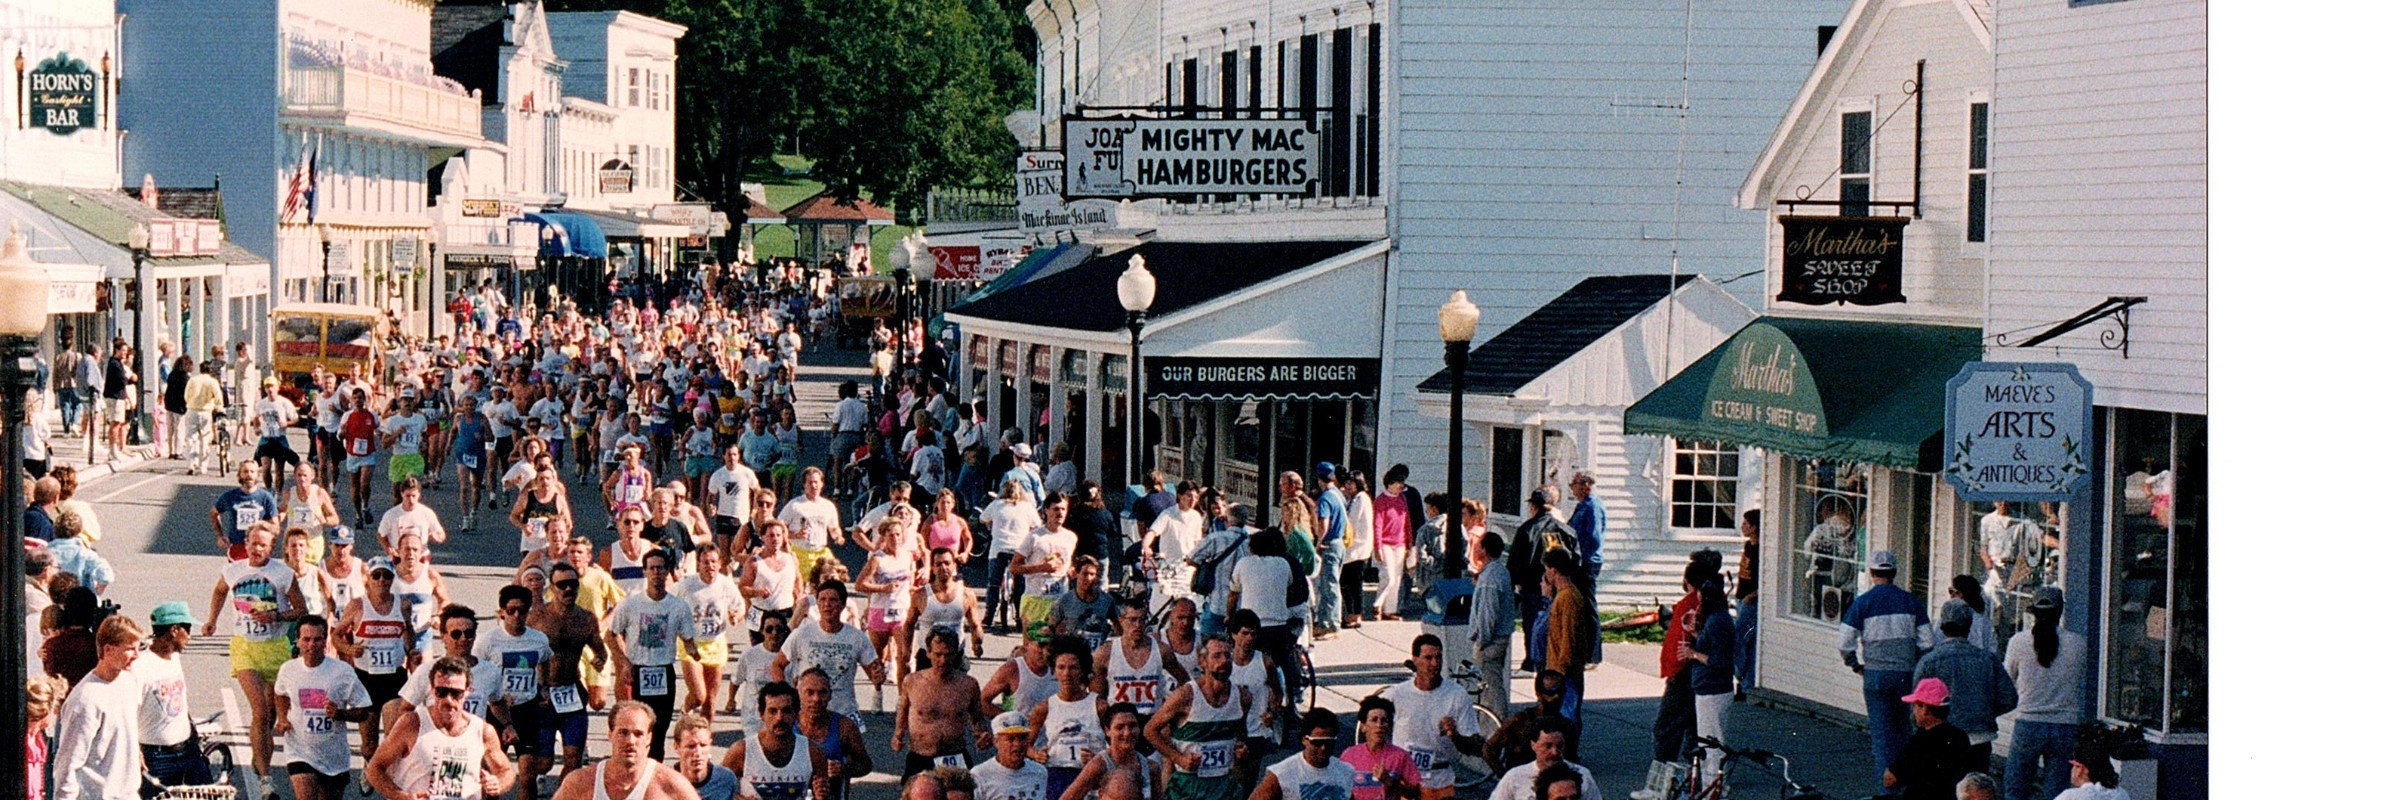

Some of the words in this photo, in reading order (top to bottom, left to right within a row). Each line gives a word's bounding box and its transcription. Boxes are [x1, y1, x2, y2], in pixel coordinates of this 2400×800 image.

[32, 73, 93, 91] HORN'S
[46, 109, 80, 126] BAR
[1142, 128, 1244, 151] MIGHTY
[1252, 128, 1305, 151] MAC
[1137, 158, 1308, 186] HAMBURGERS
[1025, 175, 1059, 197] BEN
[1021, 209, 1071, 228] Mackinac
[1787, 226, 1898, 256] Martha's
[1801, 260, 1881, 276] SWEET
[1812, 278, 1868, 295] SHOP
[1162, 366, 1192, 381] OUR
[1198, 366, 1265, 381] BURGERS
[1270, 365, 1298, 381] ARE
[1303, 365, 1356, 381] BIGGER
[1731, 341, 1797, 396] Martha's
[1712, 400, 1724, 418] ICE
[1726, 401, 1753, 420] CREAM
[1766, 406, 1793, 428] SWEET
[1795, 411, 1817, 432] SHOP
[1978, 411, 2056, 438] ARTS
[2012, 442, 2027, 461] &
[1977, 465, 2056, 485] ANTIQUES
[240, 513, 256, 523] 525
[301, 512, 306, 522] 2
[371, 651, 392, 665] 511
[506, 675, 529, 690] 571
[644, 673, 664, 687] 507
[553, 689, 575, 705] 677
[1115, 681, 1159, 702] XTC
[307, 717, 332, 732] 426
[1069, 745, 1076, 760] 1
[1201, 750, 1225, 767] 254
